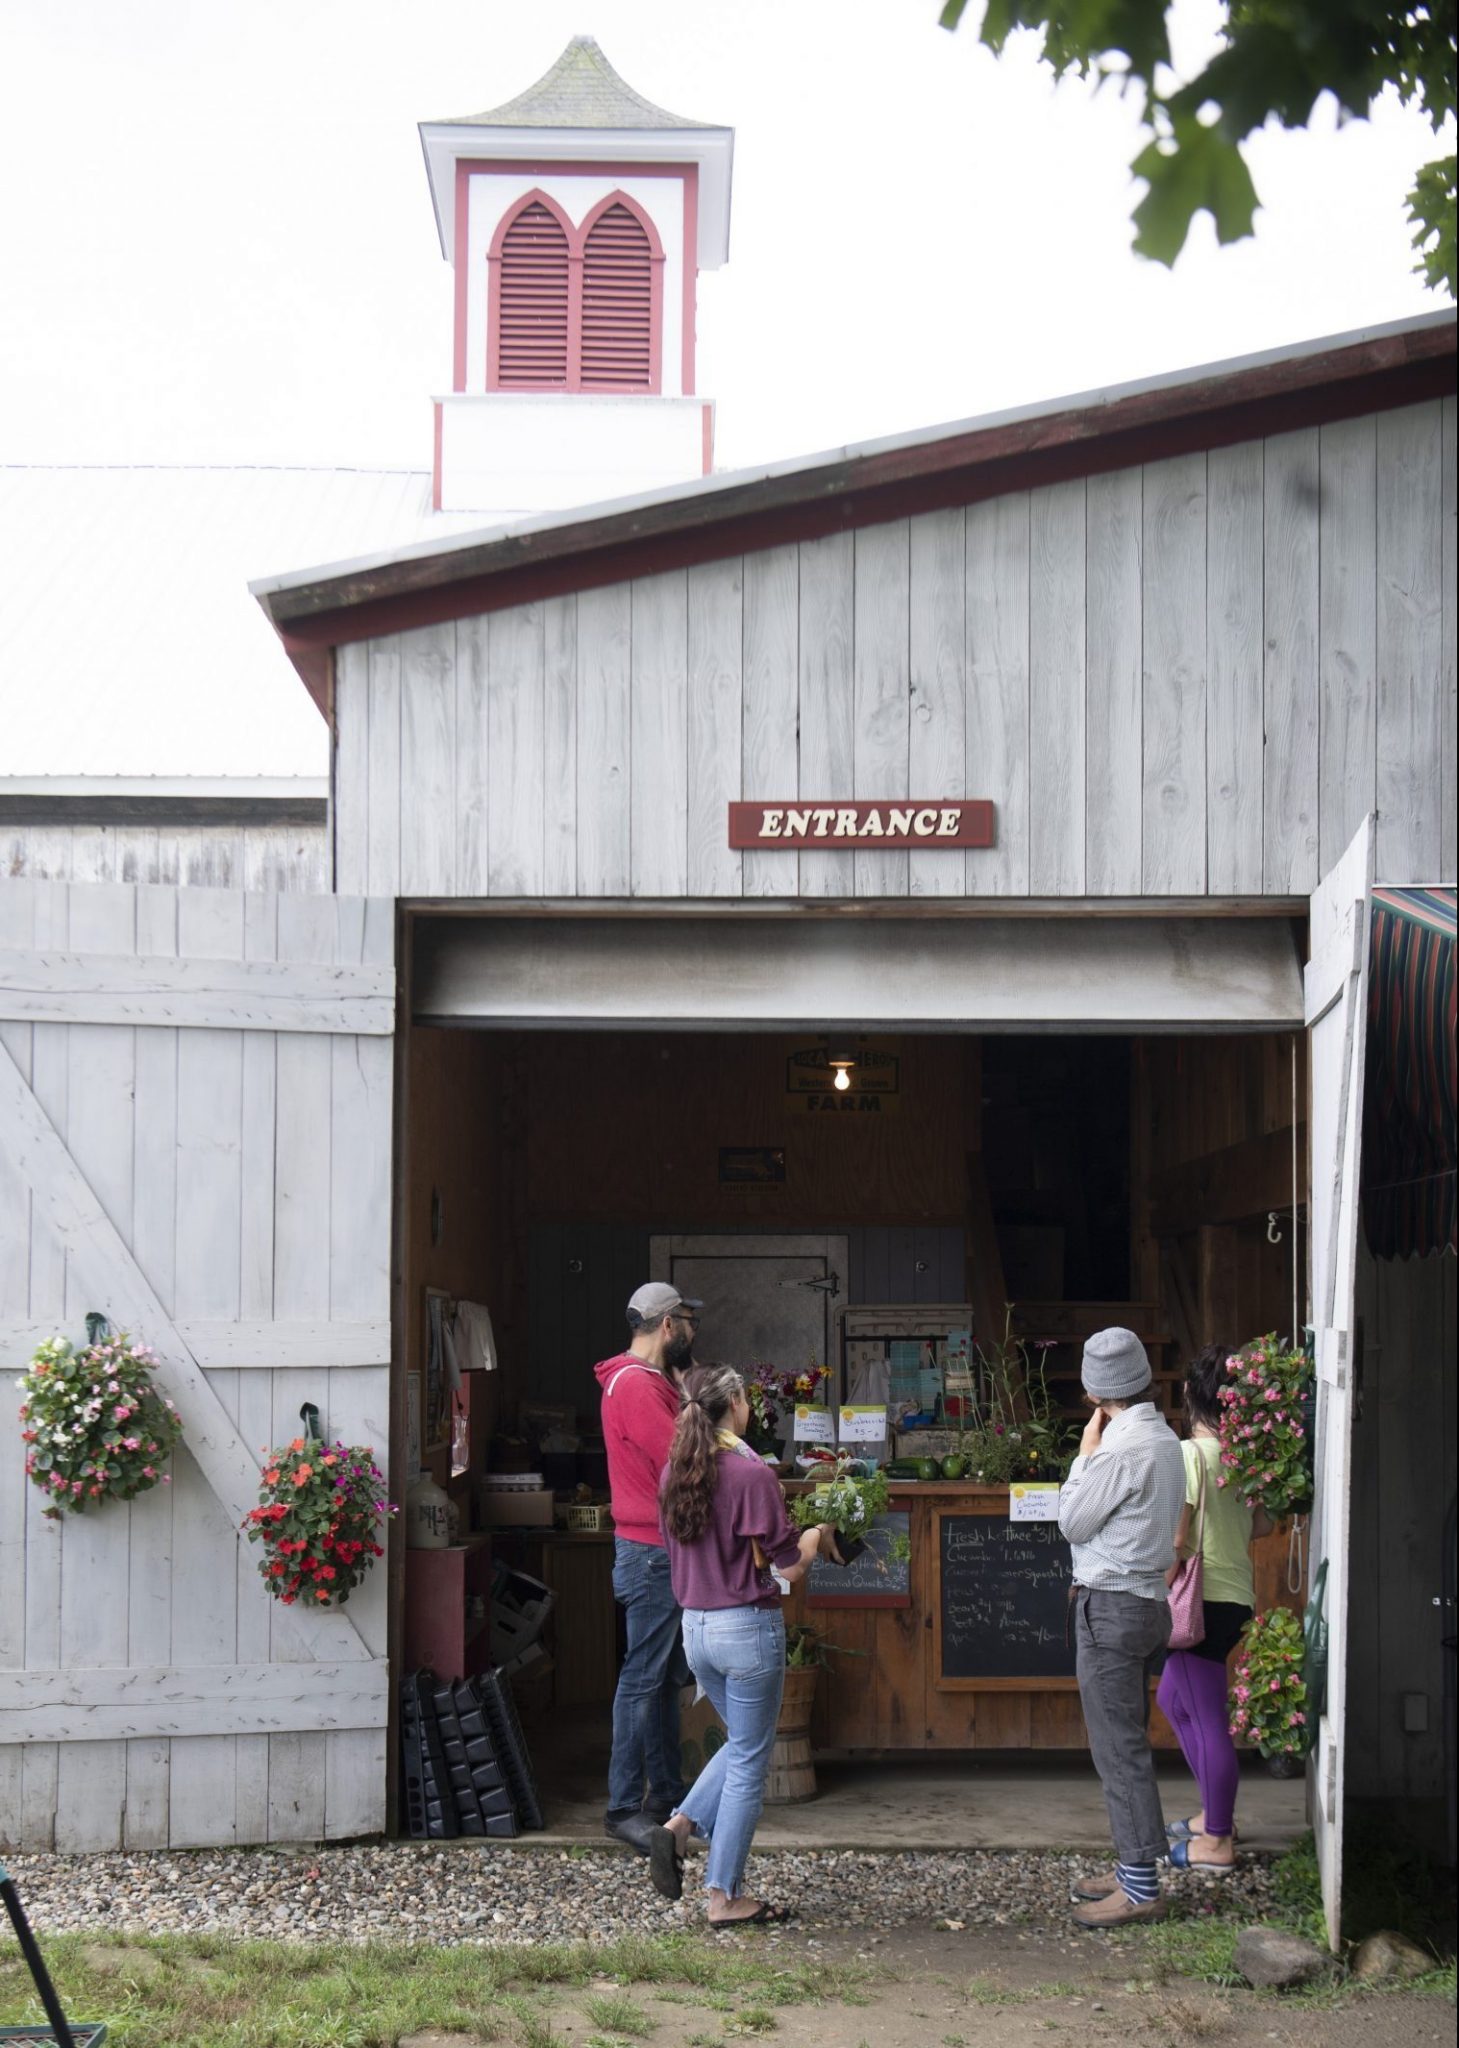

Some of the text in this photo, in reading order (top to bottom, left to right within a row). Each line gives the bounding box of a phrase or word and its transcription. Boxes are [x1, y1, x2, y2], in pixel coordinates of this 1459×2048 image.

[759, 809, 962, 838] ENTRANCE
[807, 1095, 881, 1111] FARM
[944, 1523, 984, 1546] Fresh
[1024, 1568, 1057, 1588] Squash
